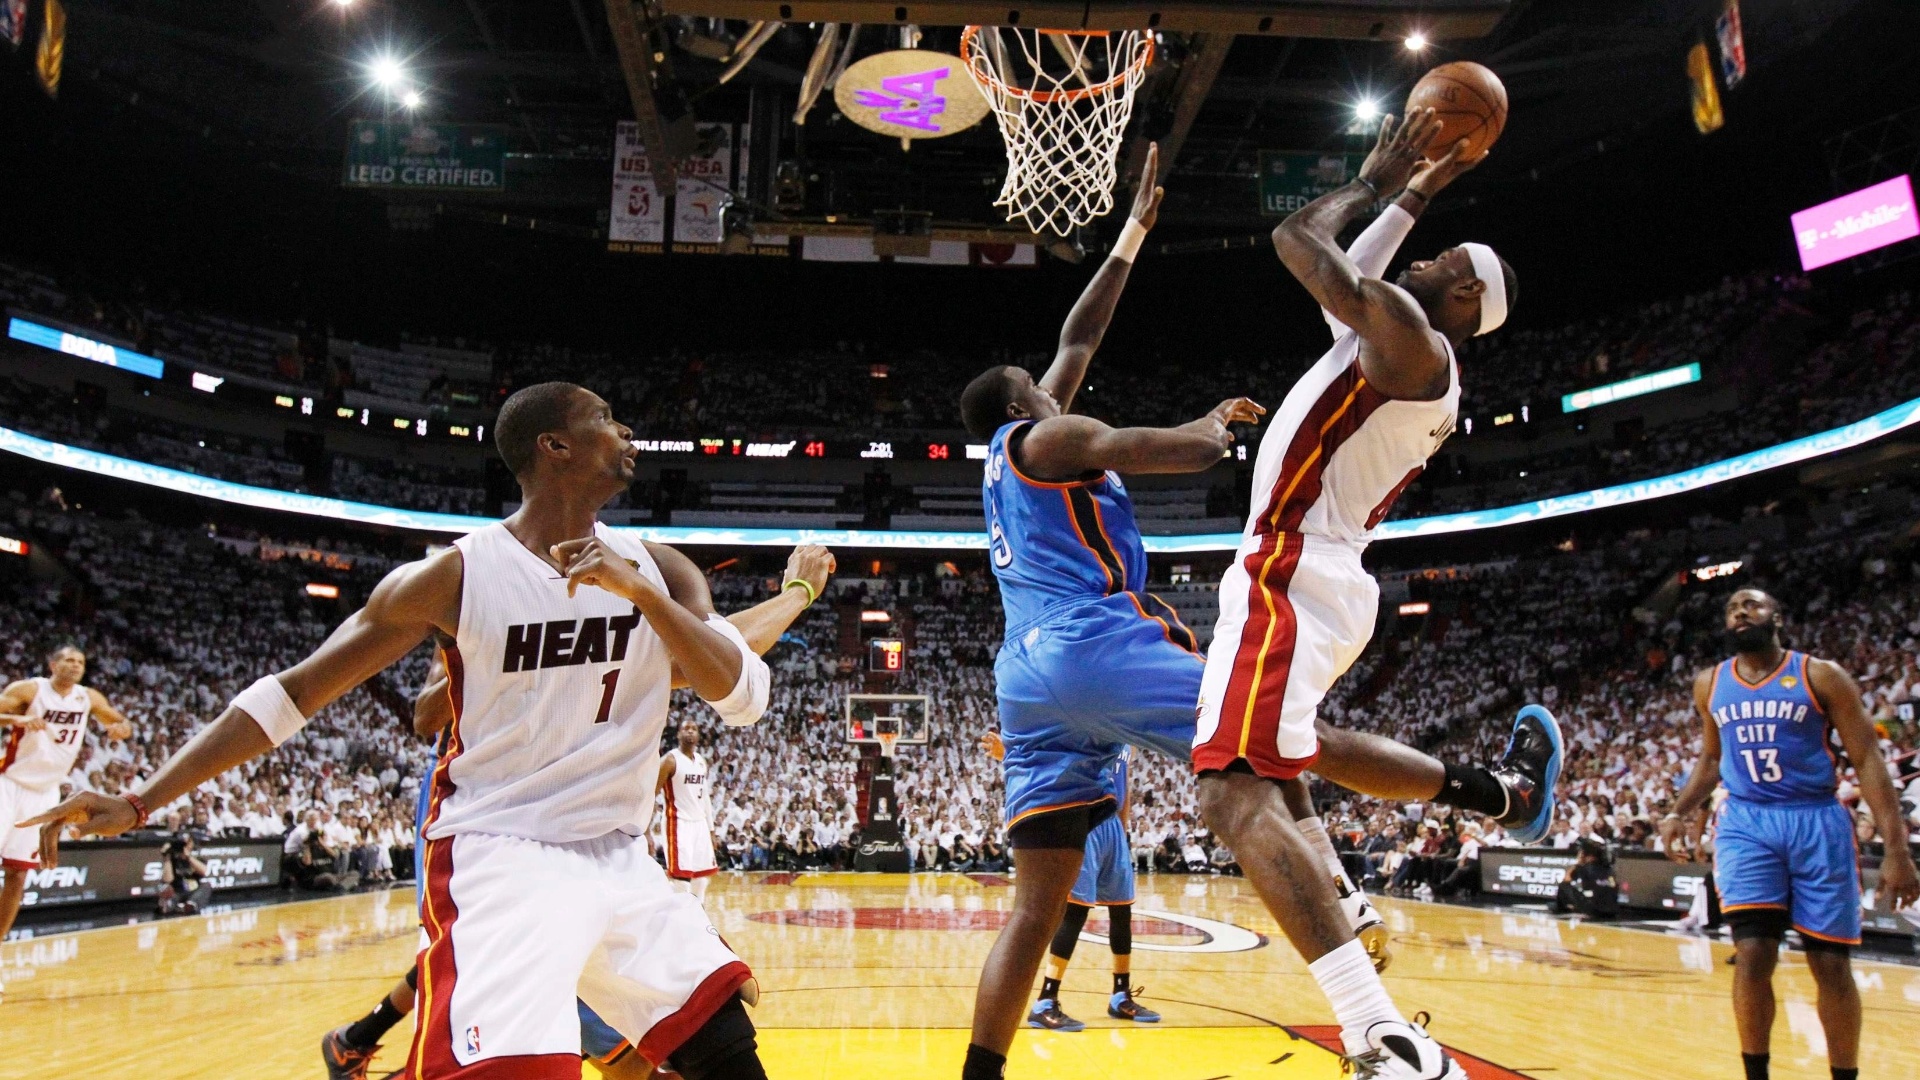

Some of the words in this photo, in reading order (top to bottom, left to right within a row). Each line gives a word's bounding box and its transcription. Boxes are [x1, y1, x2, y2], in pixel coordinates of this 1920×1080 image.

[350, 164, 395, 183] LEED
[660, 440, 694, 452] STATS
[804, 442, 825, 457] 41
[869, 442, 892, 452] 7:01
[928, 443, 949, 460] 34
[503, 605, 642, 673] HEAT
[887, 651, 899, 669] 8
[594, 668, 621, 724] 1
[43, 709, 84, 724] HEAT
[55, 729, 78, 745] 31
[1735, 724, 1777, 743] CITY
[1740, 749, 1783, 783] 13
[684, 774, 705, 785] HEAT
